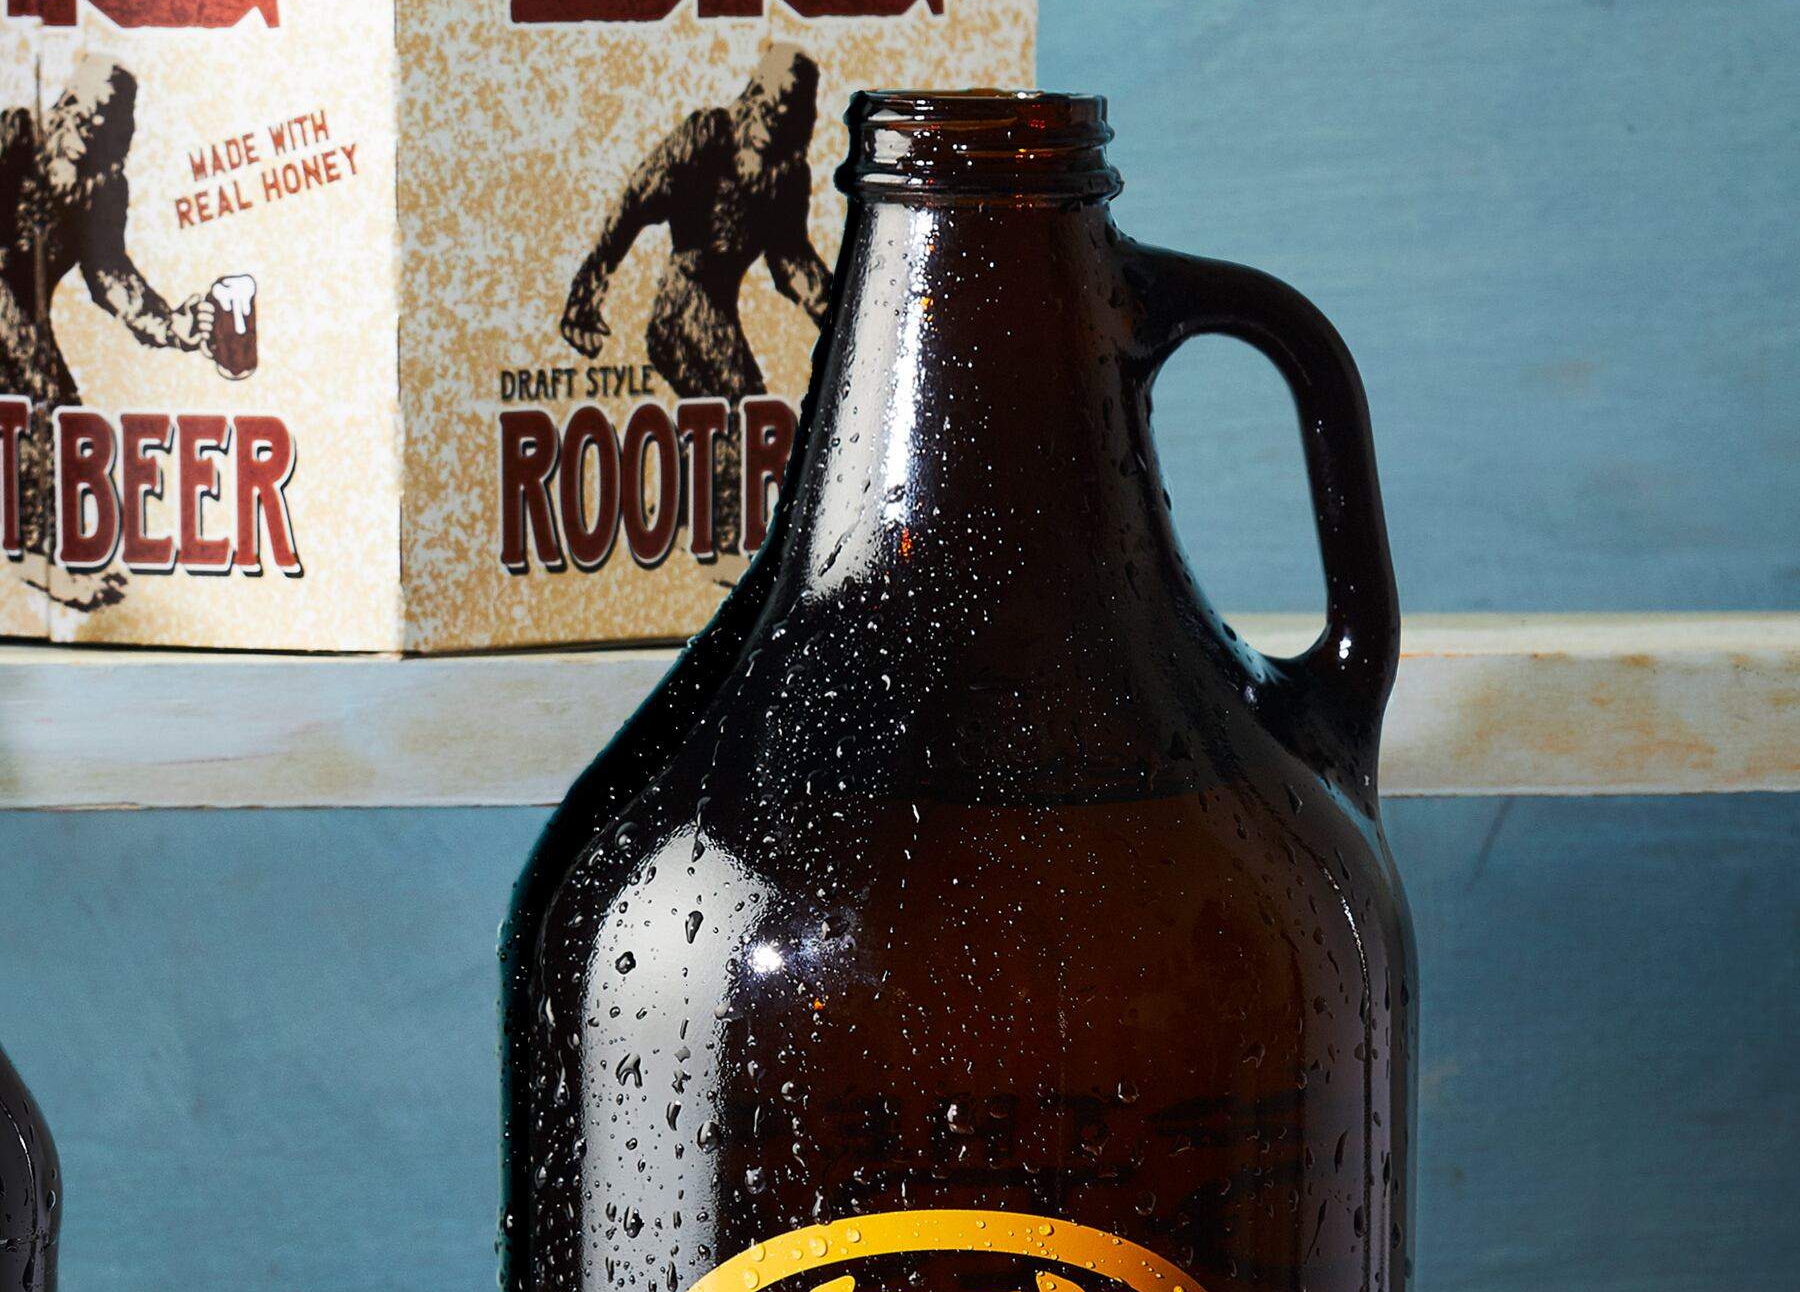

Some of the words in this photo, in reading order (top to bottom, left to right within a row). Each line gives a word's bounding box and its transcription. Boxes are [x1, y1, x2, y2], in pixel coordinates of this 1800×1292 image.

[175, 180, 253, 229] REAL
[262, 143, 358, 202] HONEY
[189, 132, 260, 182] MADE
[268, 110, 329, 155] WITH
[500, 368, 579, 401] DRAFT
[586, 364, 655, 398] STYLE
[53, 406, 304, 579] BEER
[499, 398, 730, 576] ROOT
